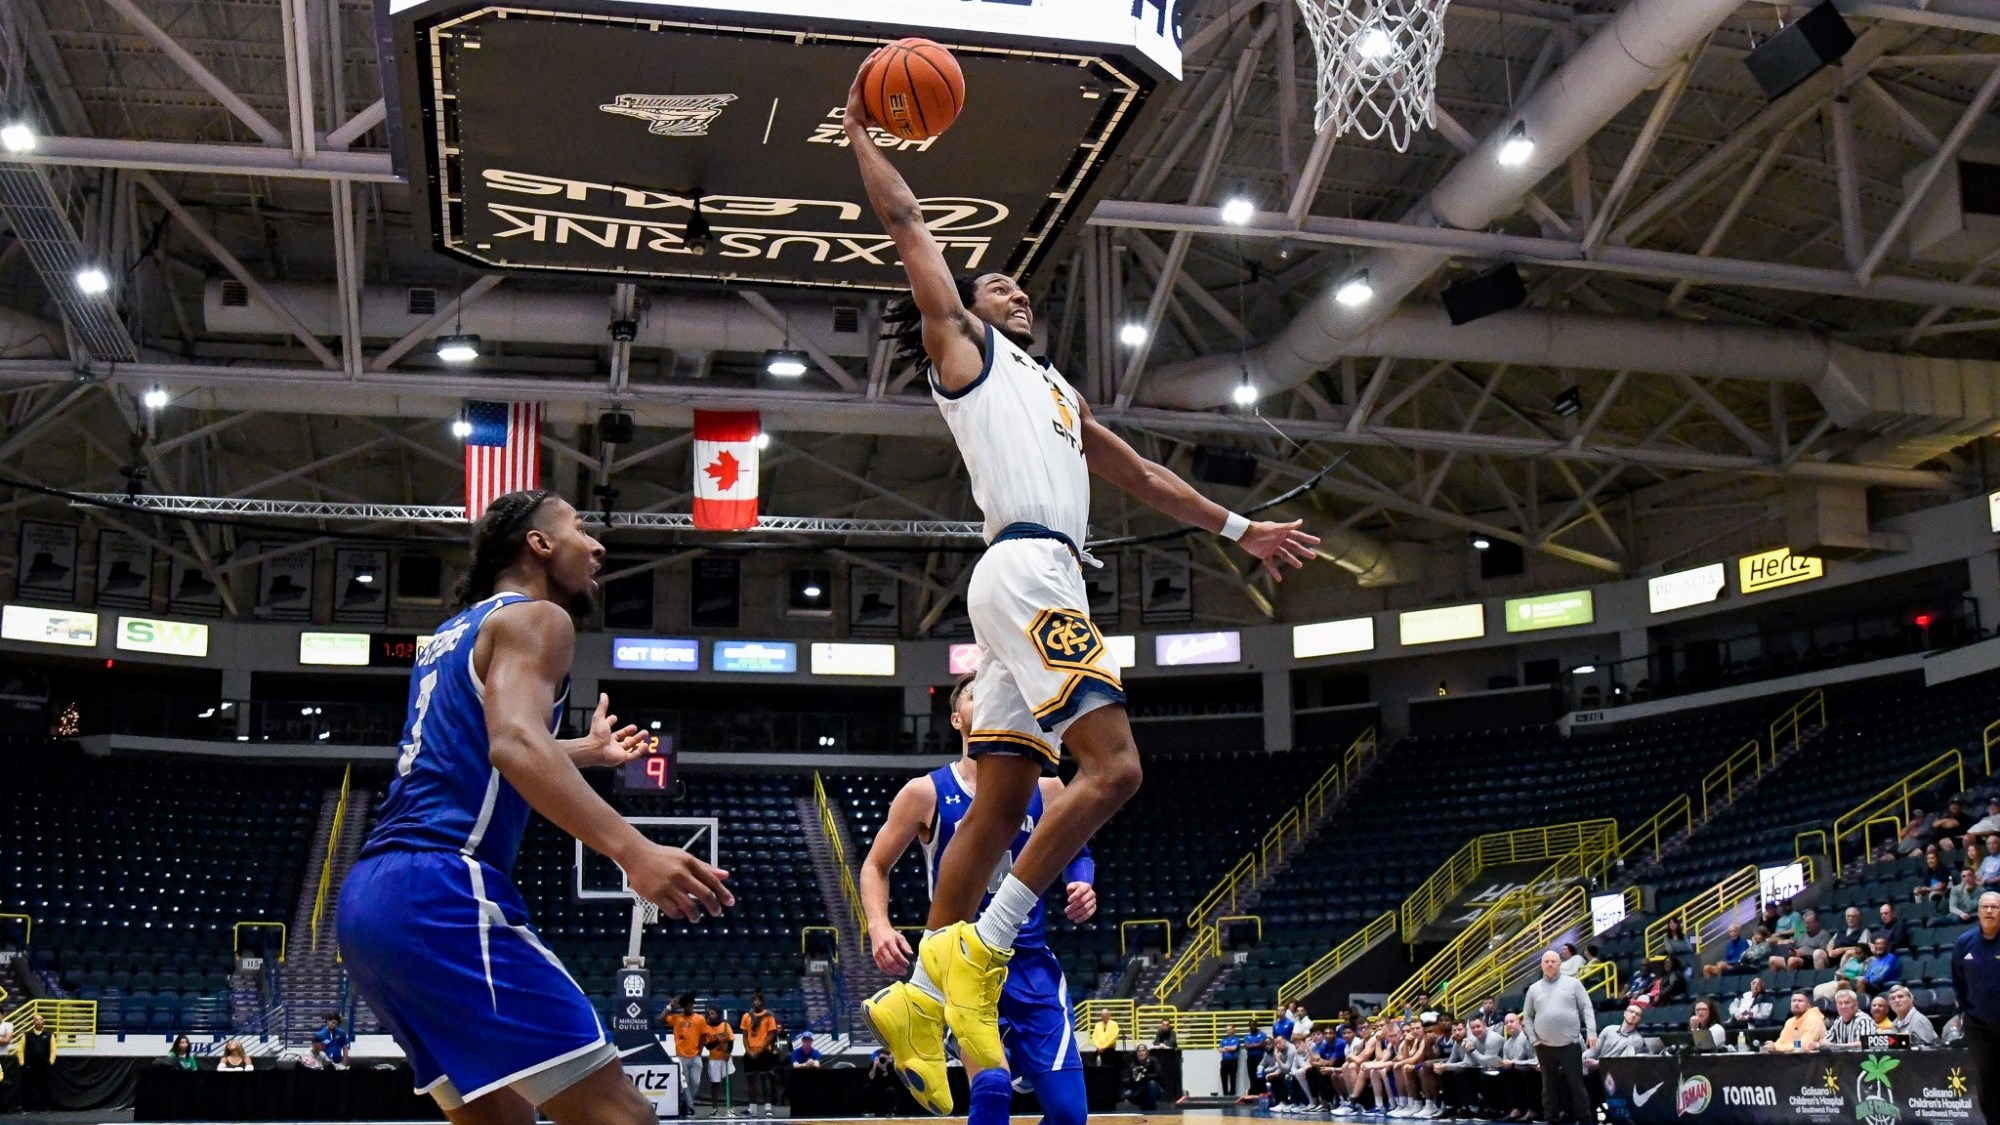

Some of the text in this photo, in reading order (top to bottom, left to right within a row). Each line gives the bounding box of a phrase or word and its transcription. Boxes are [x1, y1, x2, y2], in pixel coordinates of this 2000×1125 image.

[482, 169, 859, 220] LEXUS
[719, 232, 992, 270] LXUS
[1750, 554, 1811, 582] Hertz
[126, 619, 199, 648] SW
[647, 757, 665, 789] 9
[1868, 1035, 1889, 1047] POSS
[1722, 1085, 1777, 1106] roman
[1789, 1096, 1845, 1107] Children's Hospital
[1801, 1086, 1830, 1097] Golisano
[1923, 1087, 1953, 1098] Golisano
[1909, 1097, 1973, 1110] Children's Hospital
